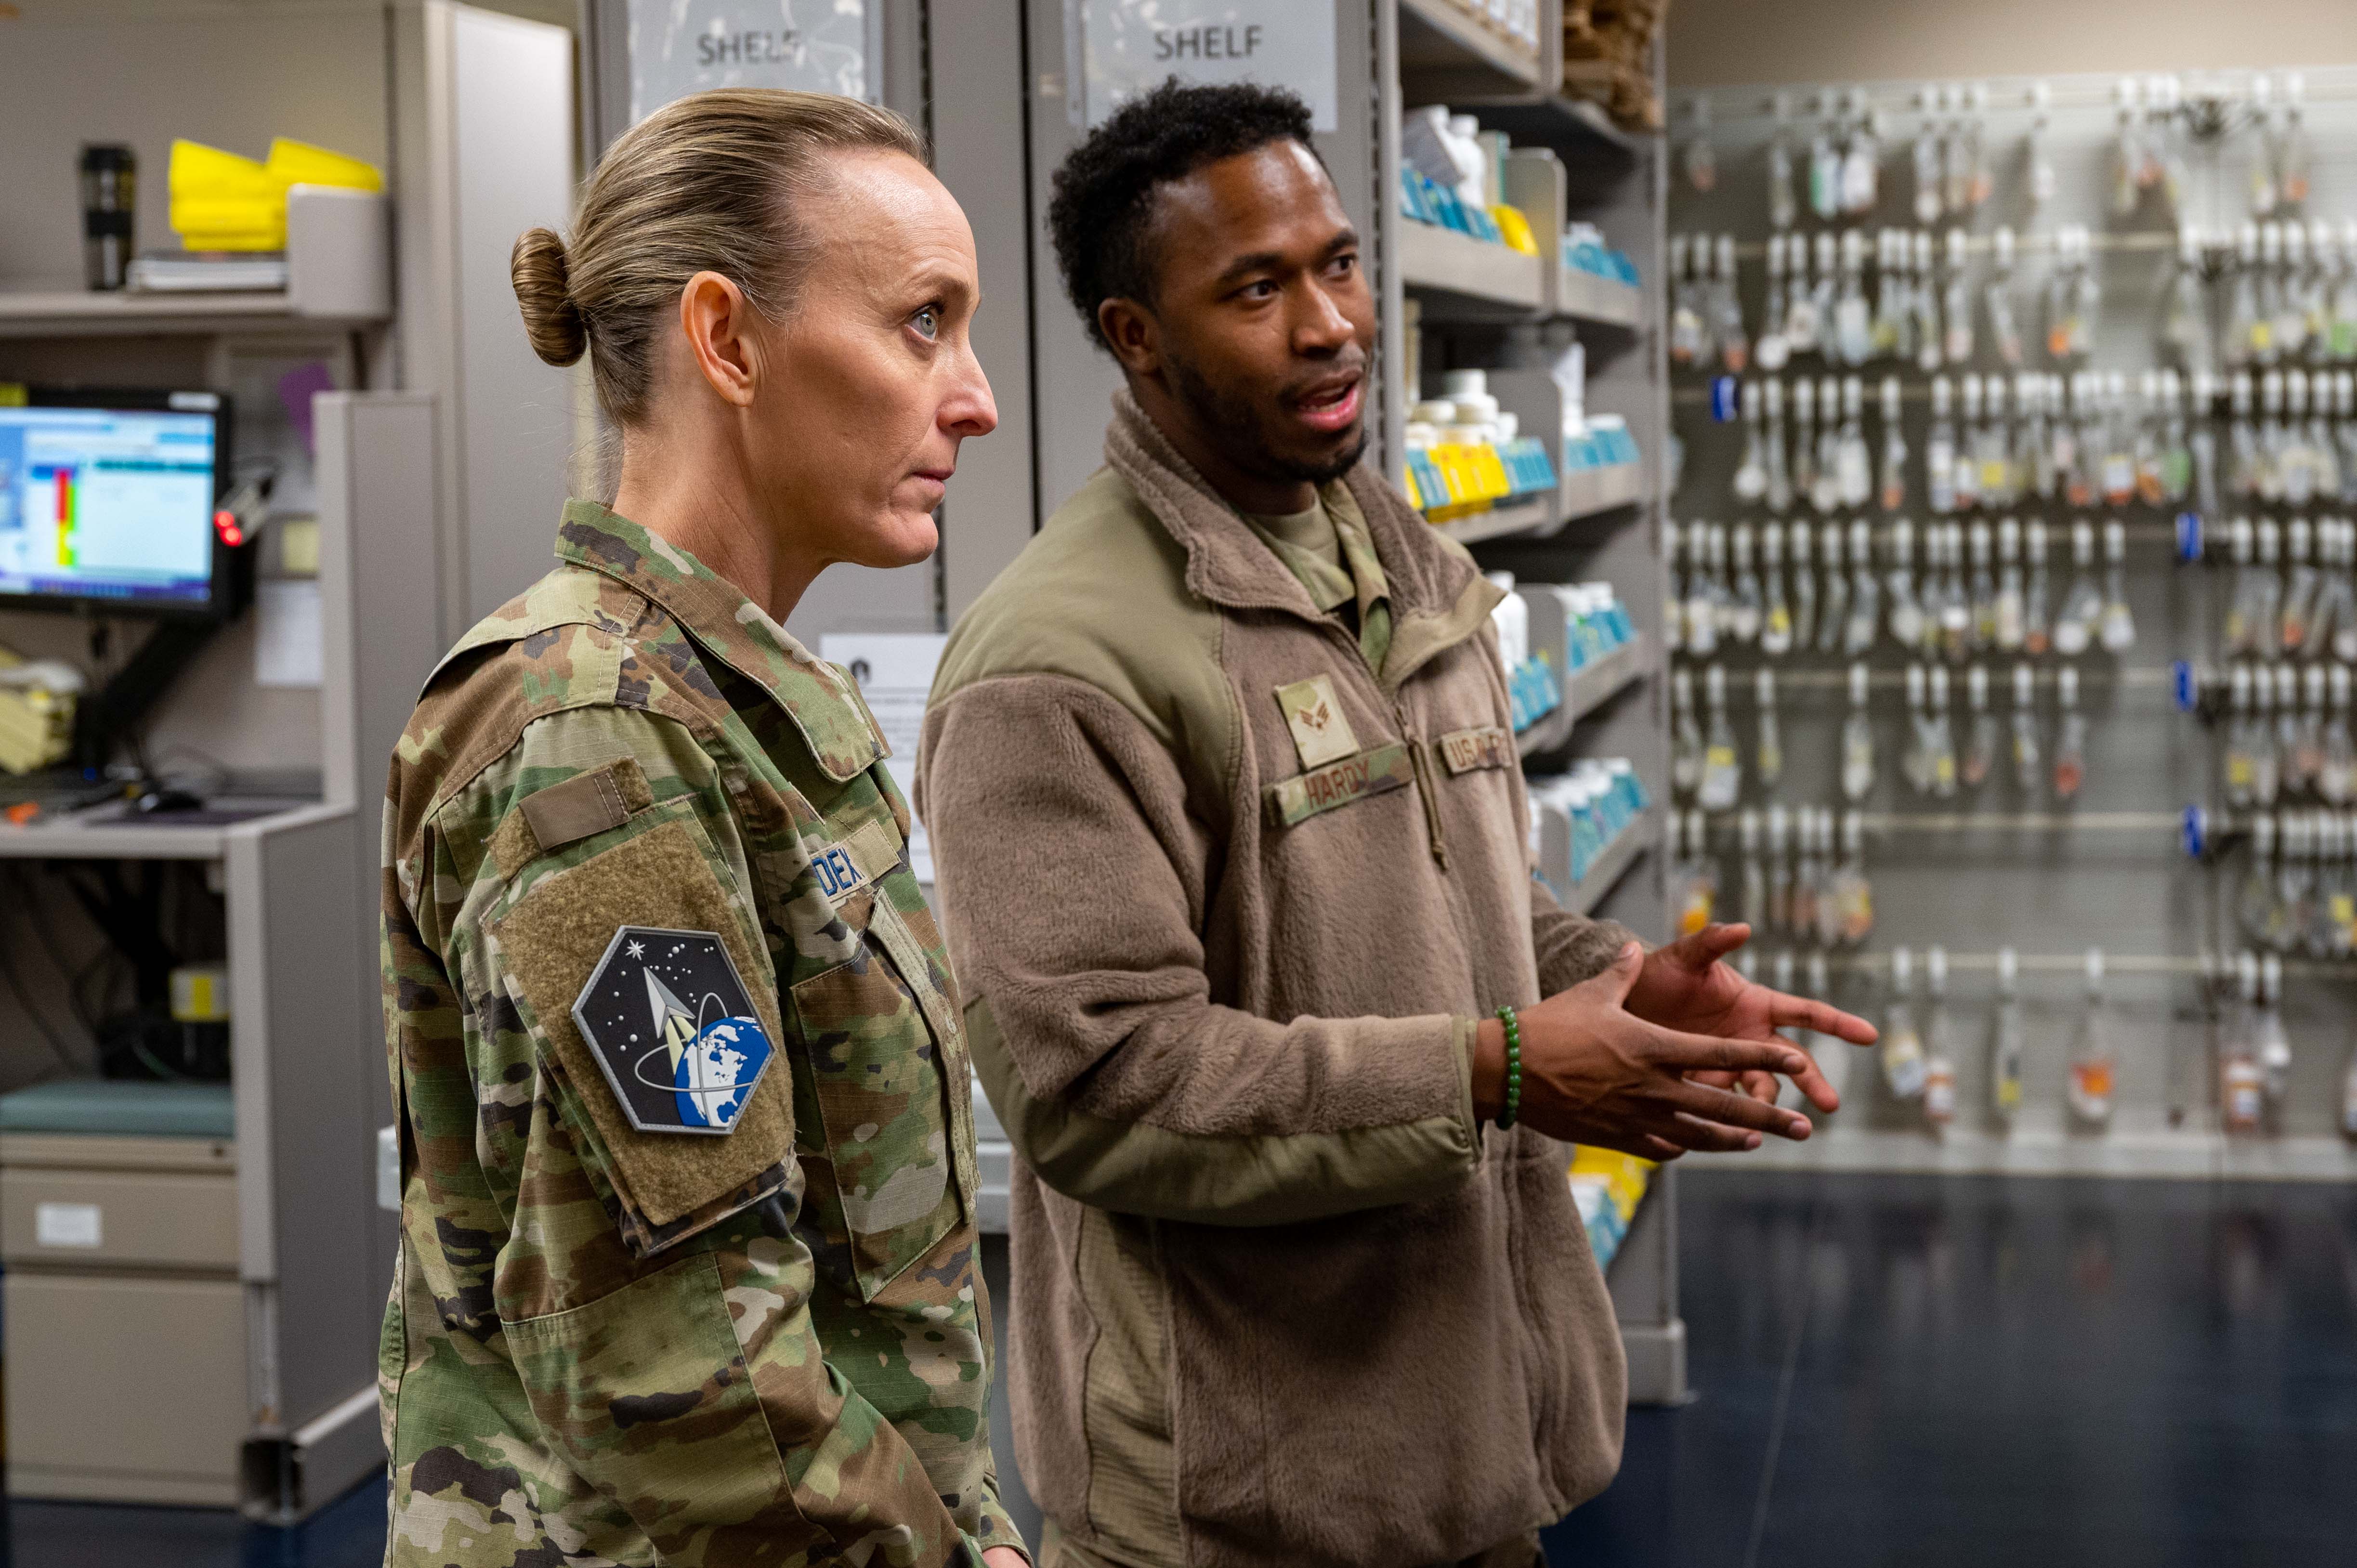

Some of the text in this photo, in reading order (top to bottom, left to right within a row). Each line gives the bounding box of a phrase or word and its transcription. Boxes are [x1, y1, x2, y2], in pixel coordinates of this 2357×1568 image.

[1154, 25, 1263, 61] SHELF
[1304, 757, 1370, 810] HARDY
[812, 846, 865, 897] DEX
